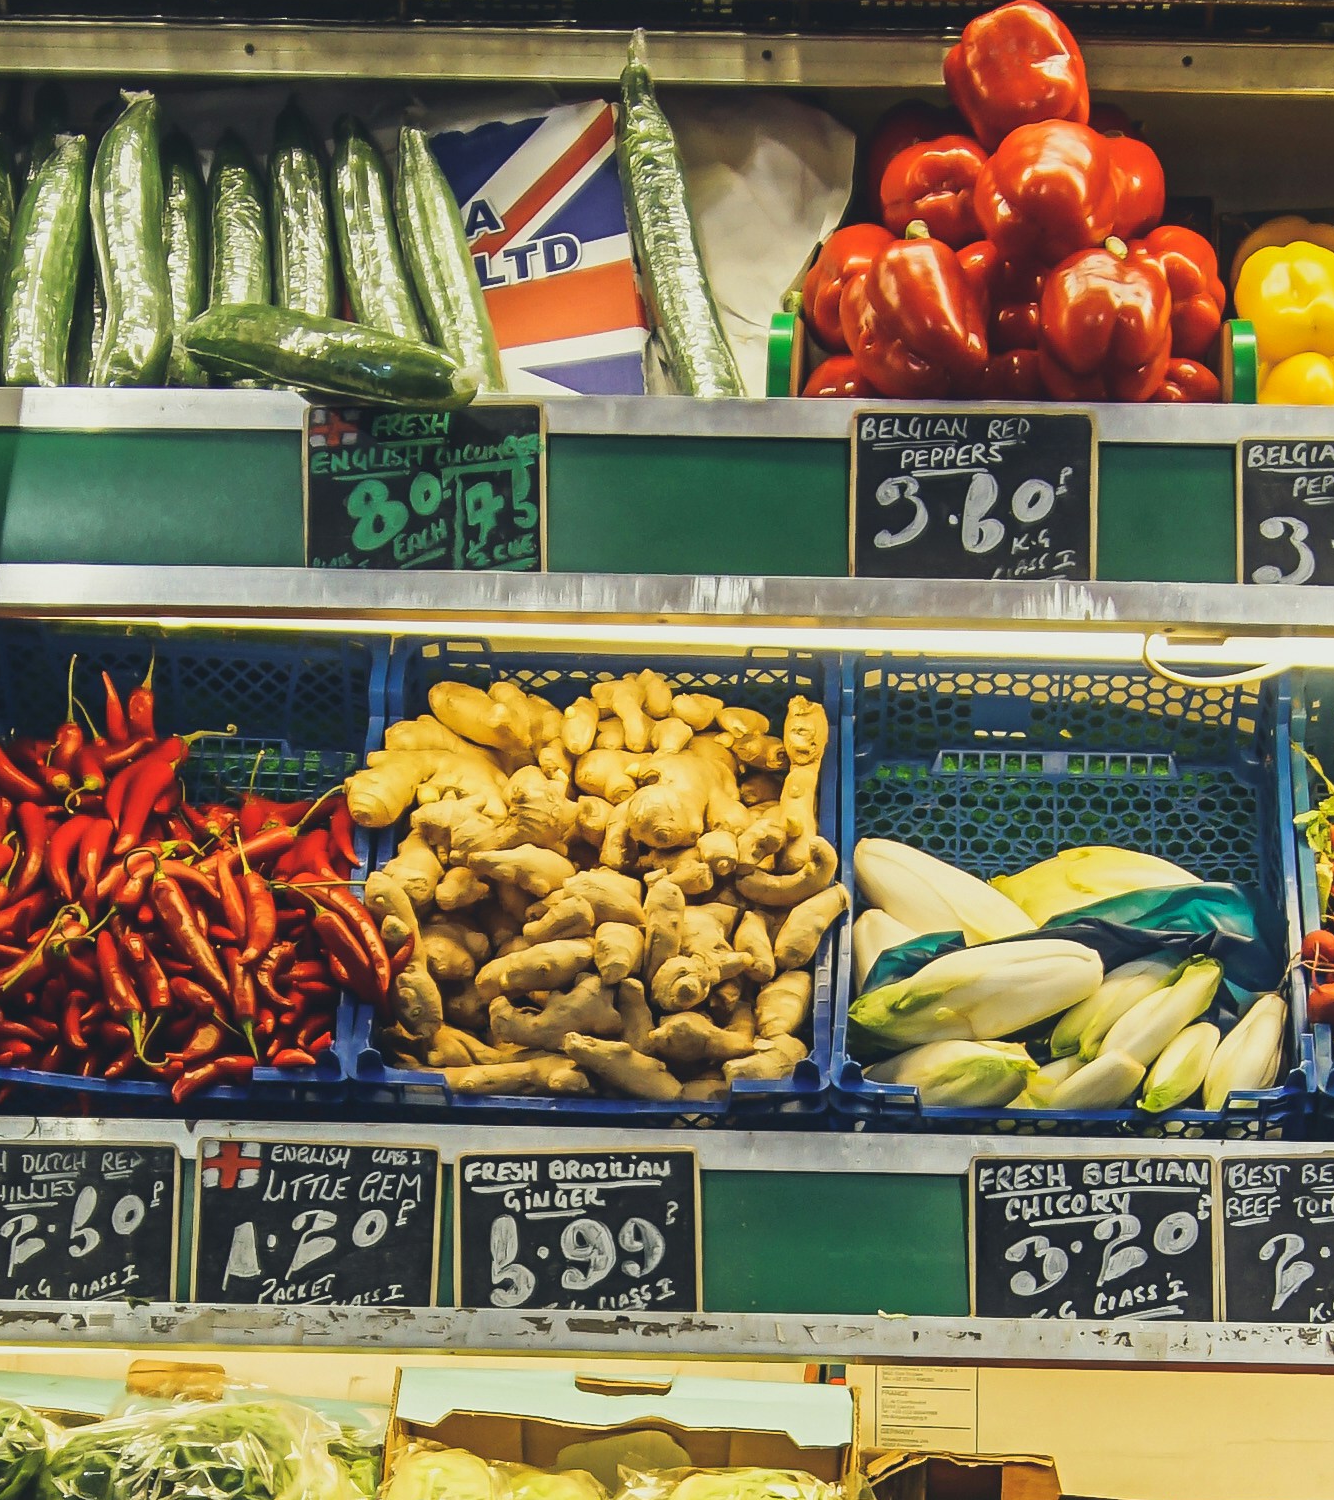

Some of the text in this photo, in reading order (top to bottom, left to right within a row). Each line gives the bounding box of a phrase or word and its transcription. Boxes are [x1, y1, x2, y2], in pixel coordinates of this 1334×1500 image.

[470, 232, 583, 291] LTD
[861, 418, 1030, 441] BELGIAN RED
[311, 448, 422, 474] ENGLISH
[901, 443, 1003, 469] PEPPERS
[22, 1152, 86, 1175] DUTCH
[102, 1151, 145, 1171] RED
[271, 1145, 351, 1169] ENGLISH
[465, 1160, 537, 1182] FRESH
[979, 1159, 1209, 1191] FRESH BELGIAN
[1228, 1163, 1290, 1188] BEST
[263, 1170, 421, 1202] LITTLE GEM
[1006, 1193, 1131, 1220] CHICORY
[1225, 1196, 1281, 1218] BEEF
[258, 1274, 335, 1304] PACKET
